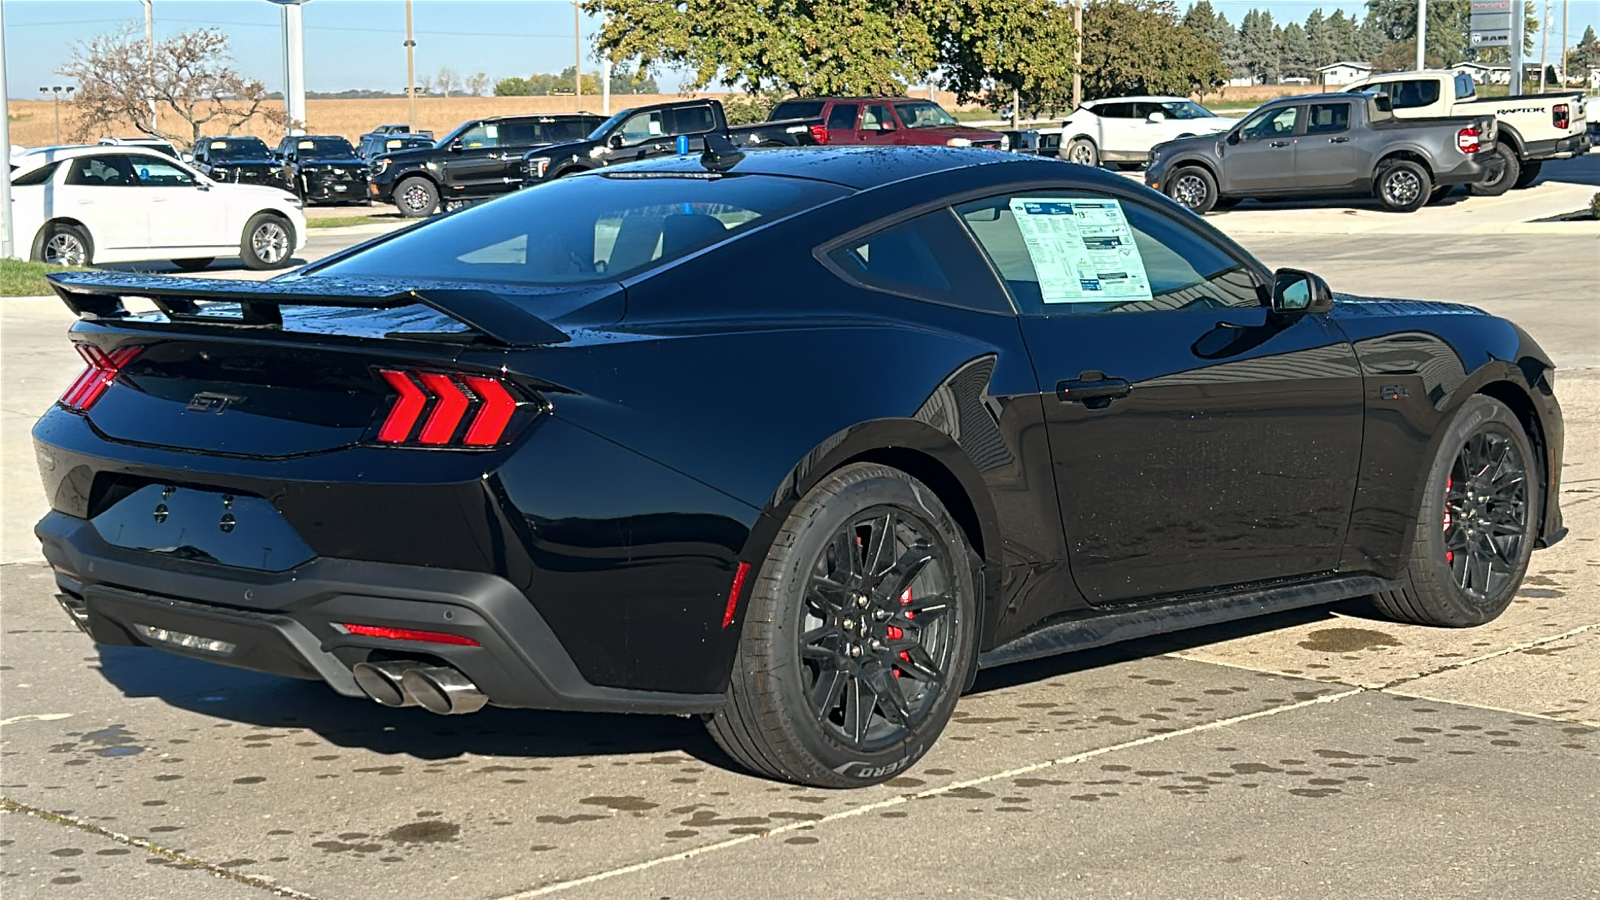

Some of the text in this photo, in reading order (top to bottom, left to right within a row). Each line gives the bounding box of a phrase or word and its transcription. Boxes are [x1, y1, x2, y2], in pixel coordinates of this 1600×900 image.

[1496, 106, 1546, 116] RAPTOR
[186, 391, 247, 416] GT
[857, 755, 910, 778] ZERO
